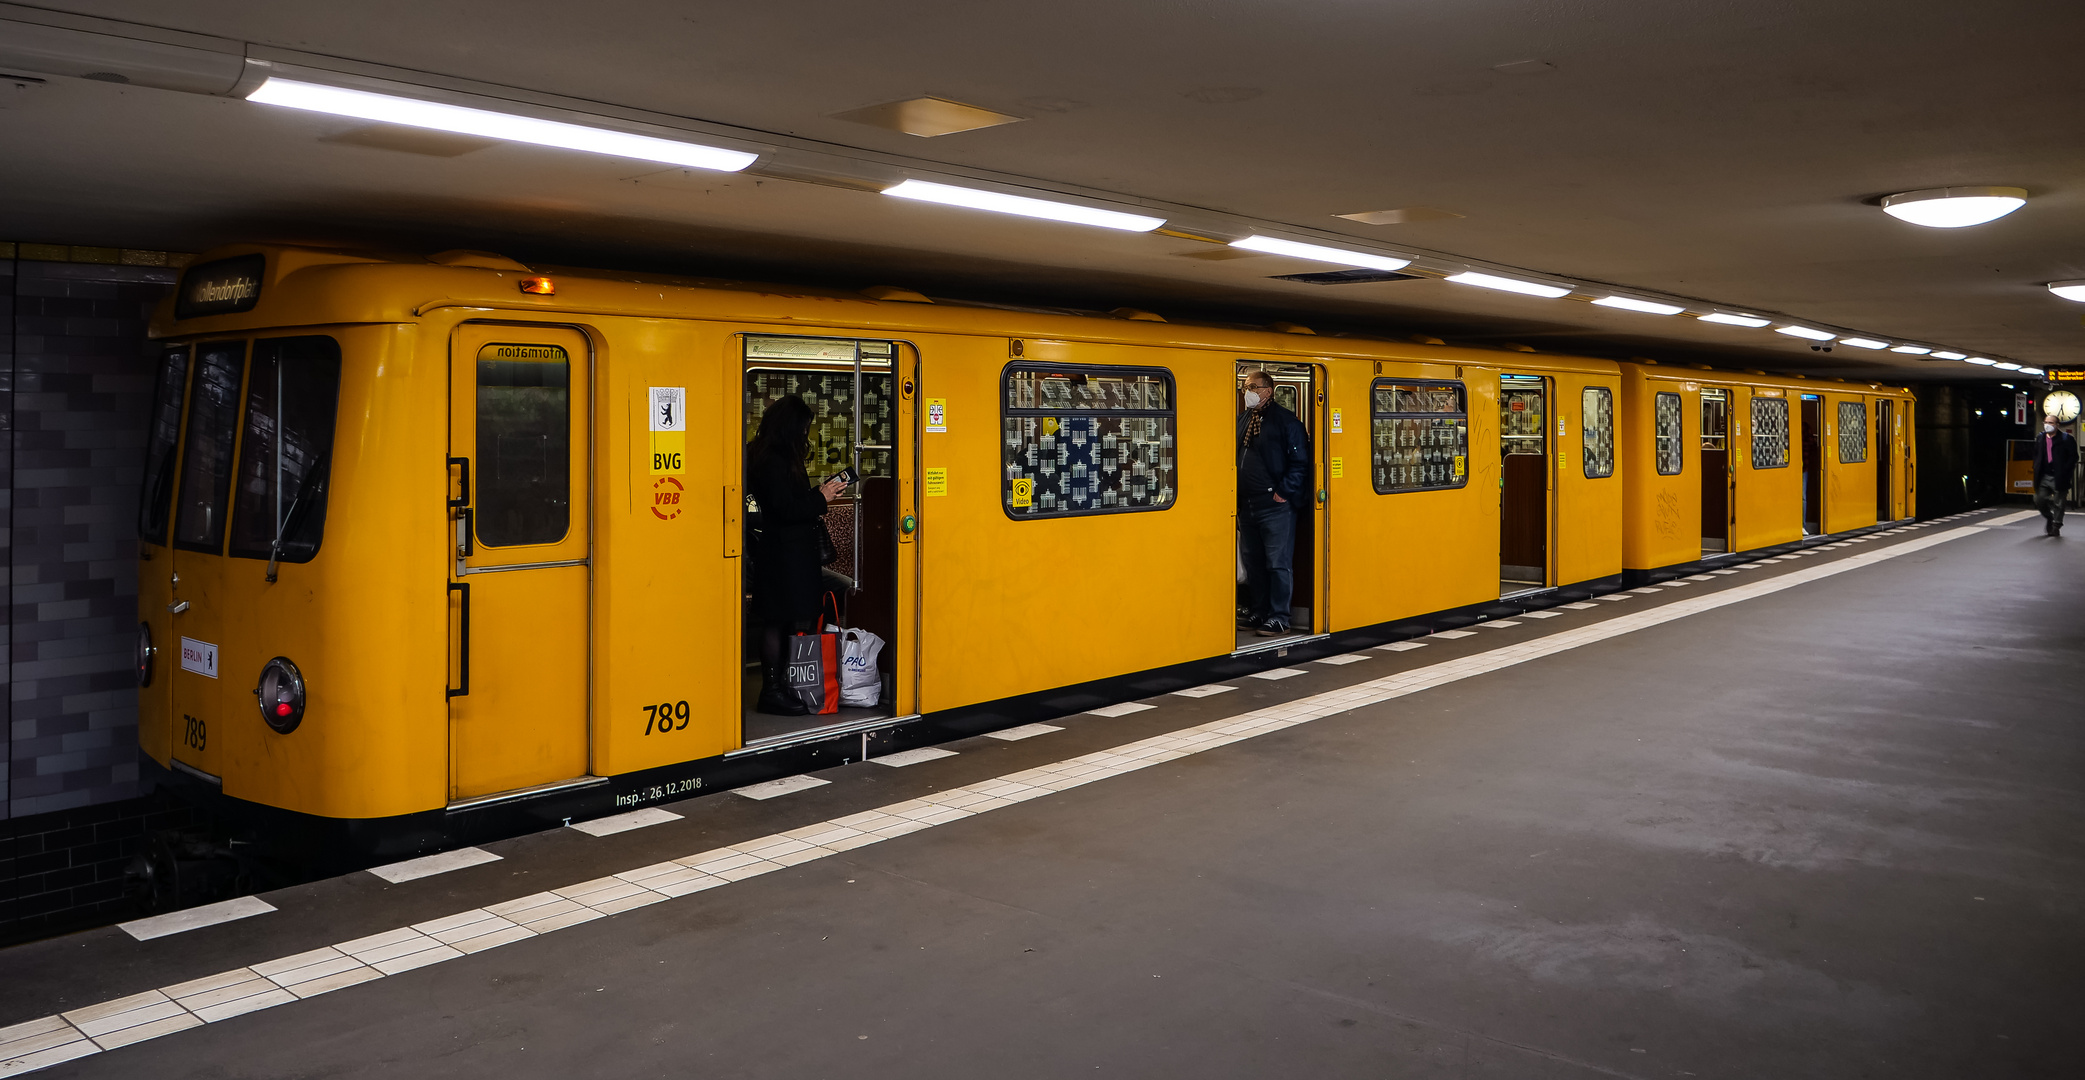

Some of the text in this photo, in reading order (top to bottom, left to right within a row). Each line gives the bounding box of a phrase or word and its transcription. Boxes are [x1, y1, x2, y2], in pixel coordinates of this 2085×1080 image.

[196, 277, 260, 305] ollendorfplat
[653, 452, 682, 470] BVG
[654, 492, 680, 505] VBB
[183, 647, 203, 664] BERLIN
[643, 700, 690, 736] 789
[183, 713, 207, 752] 789
[616, 777, 702, 807] Insp.: 26.12.2018
